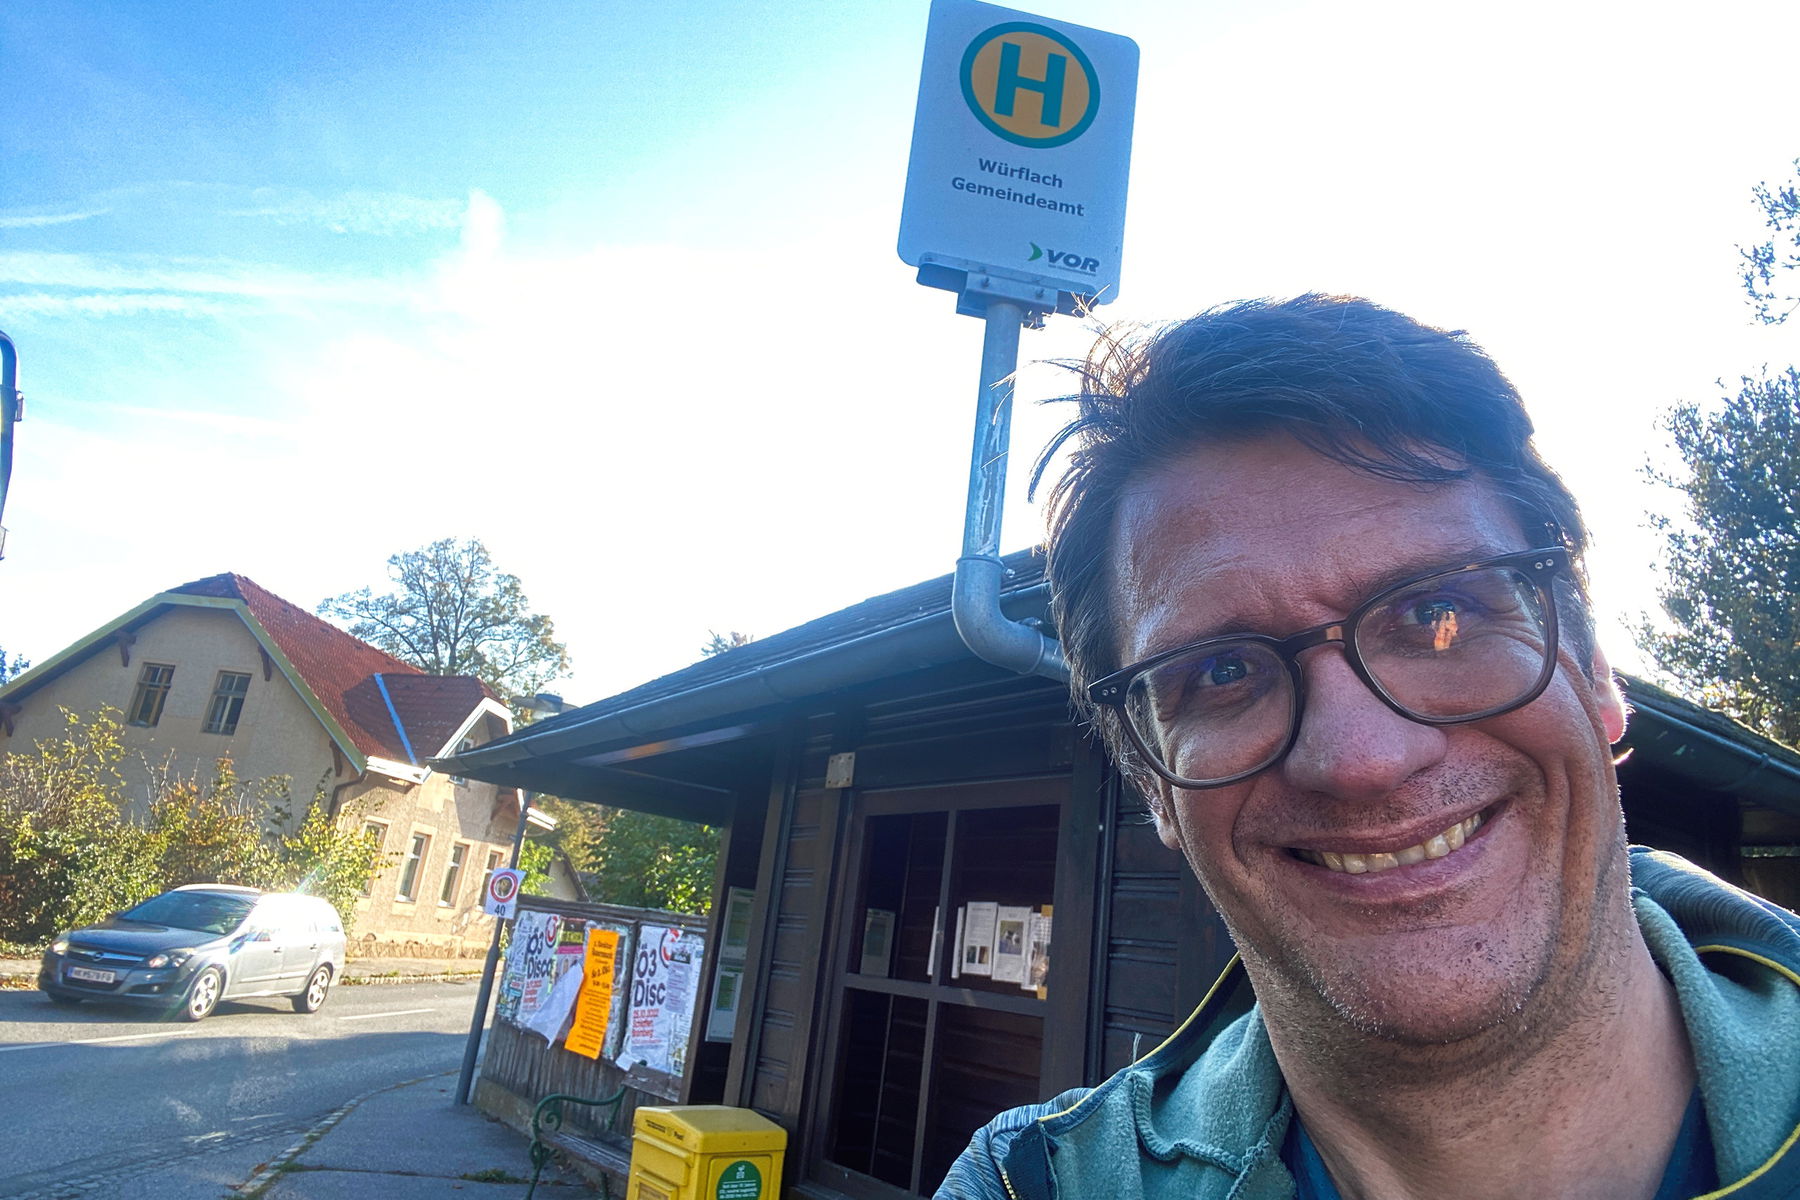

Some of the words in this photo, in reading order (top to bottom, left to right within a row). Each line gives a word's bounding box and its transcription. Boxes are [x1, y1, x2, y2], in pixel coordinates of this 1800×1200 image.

[994, 41, 1068, 128] H
[978, 157, 1063, 188] Würflach
[952, 176, 1085, 217] Gemeindeamt
[1046, 248, 1099, 272] VOR
[494, 904, 506, 916] 40
[527, 926, 544, 955] Ö3
[527, 956, 552, 979] Disco
[636, 942, 657, 979] Ö3
[633, 978, 666, 1008] Disc
